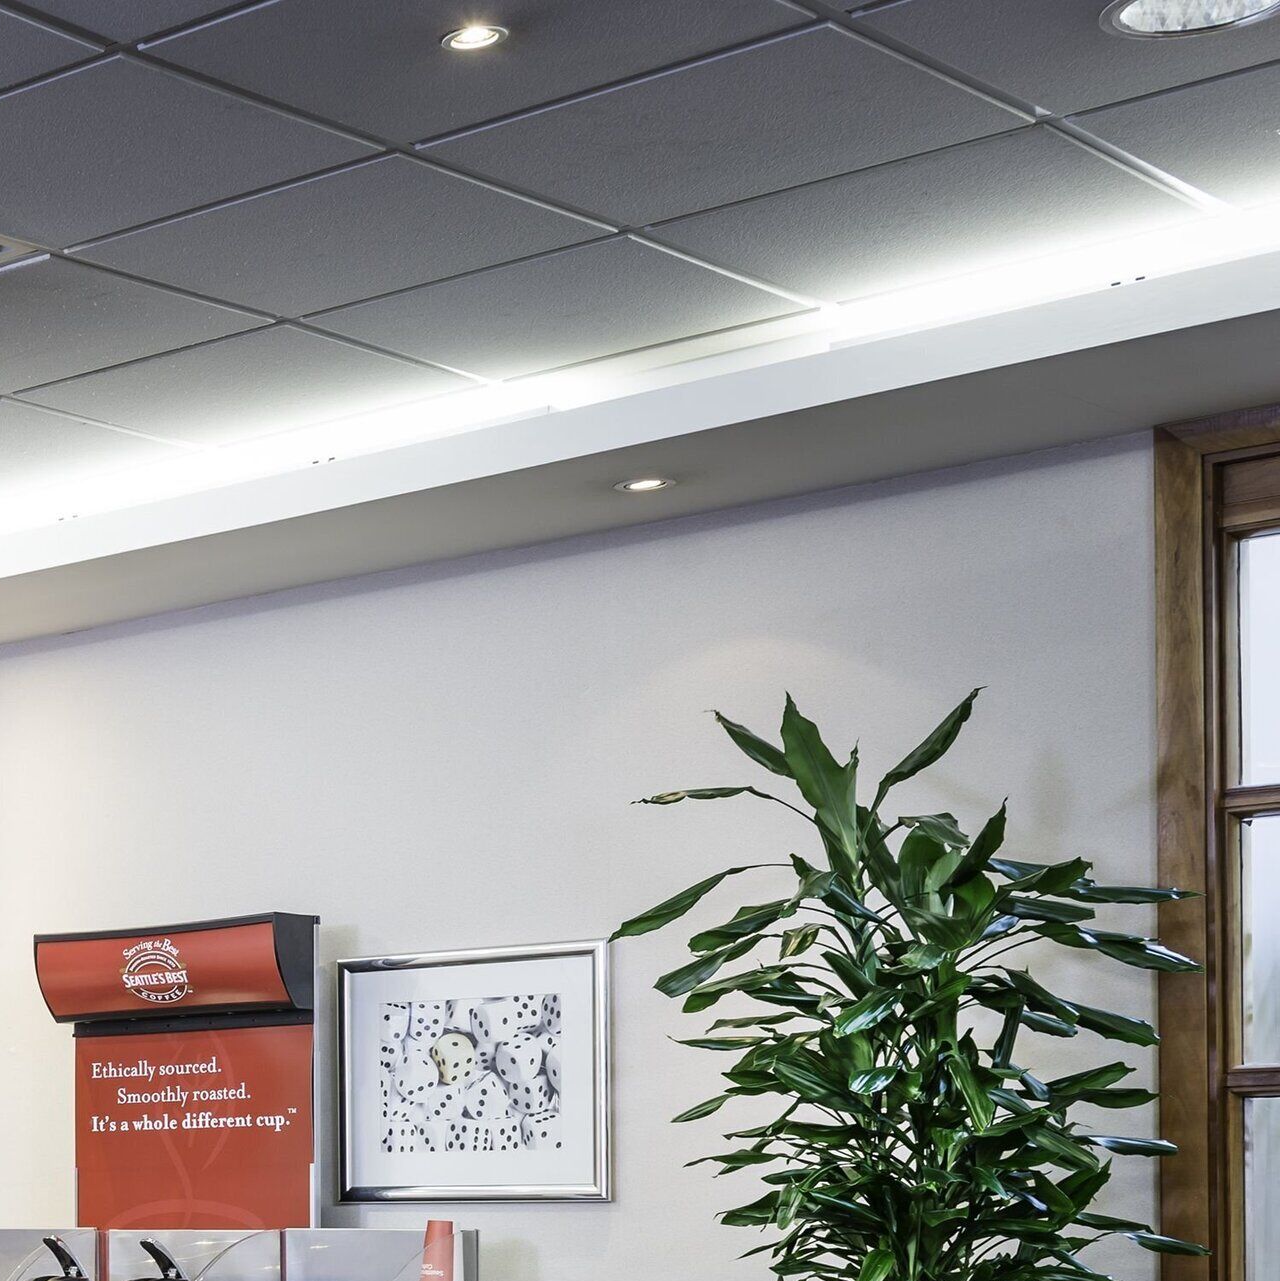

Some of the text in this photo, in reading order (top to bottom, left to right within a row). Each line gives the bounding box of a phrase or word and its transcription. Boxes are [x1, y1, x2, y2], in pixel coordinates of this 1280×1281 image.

[123, 941, 153, 960] Serving
[161, 938, 179, 957] Best
[165, 970, 188, 984] BEST
[141, 989, 182, 1001] COFFEE
[92, 1056, 222, 1082] Ethically sourced.
[117, 1083, 251, 1107] Smoothly roasted.
[91, 1116, 117, 1132] It's
[120, 1121, 129, 1131] a
[132, 1114, 178, 1131] whole
[182, 1112, 253, 1129] different
